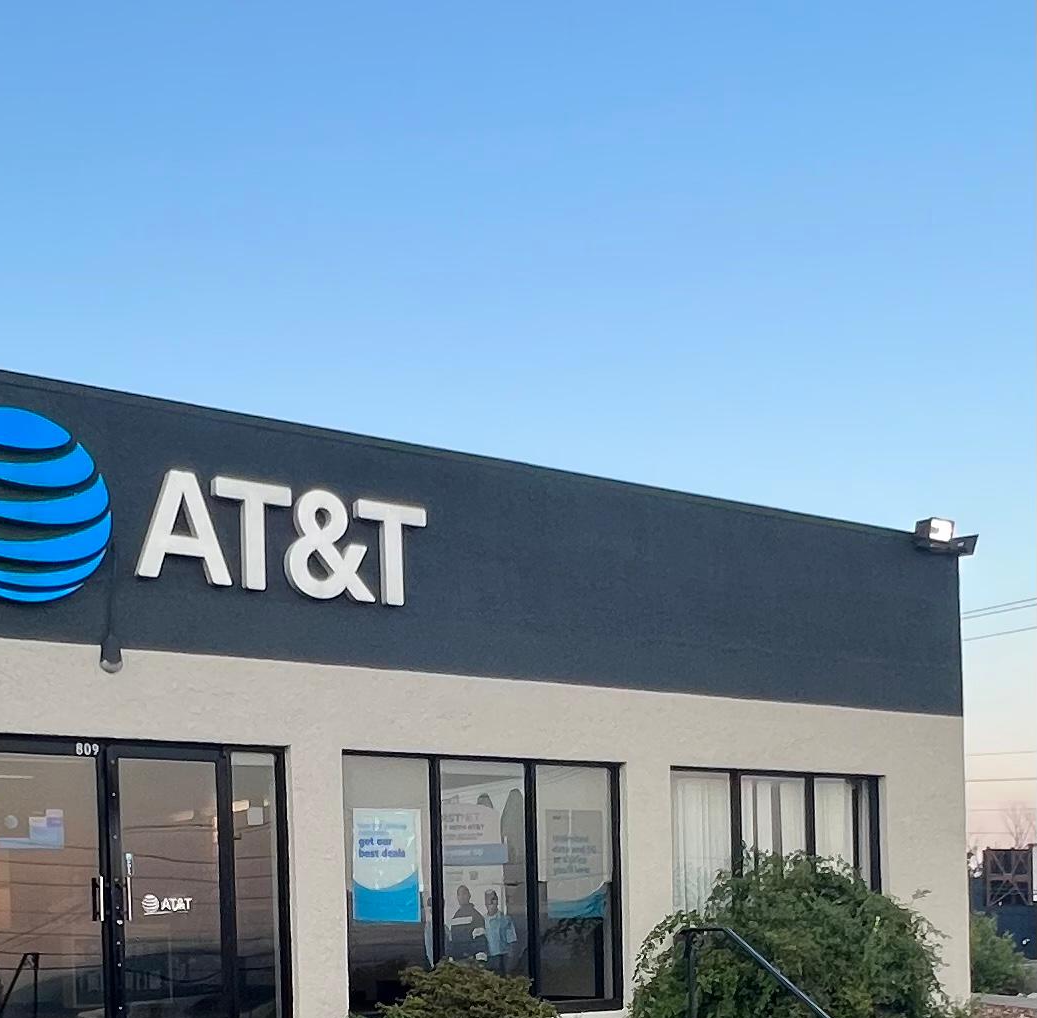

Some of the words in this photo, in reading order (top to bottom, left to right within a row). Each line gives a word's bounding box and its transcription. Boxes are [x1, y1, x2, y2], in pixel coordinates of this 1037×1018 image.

[134, 469, 427, 607] AT&T
[75, 742, 100, 756] 809
[160, 896, 193, 912] AT&T
